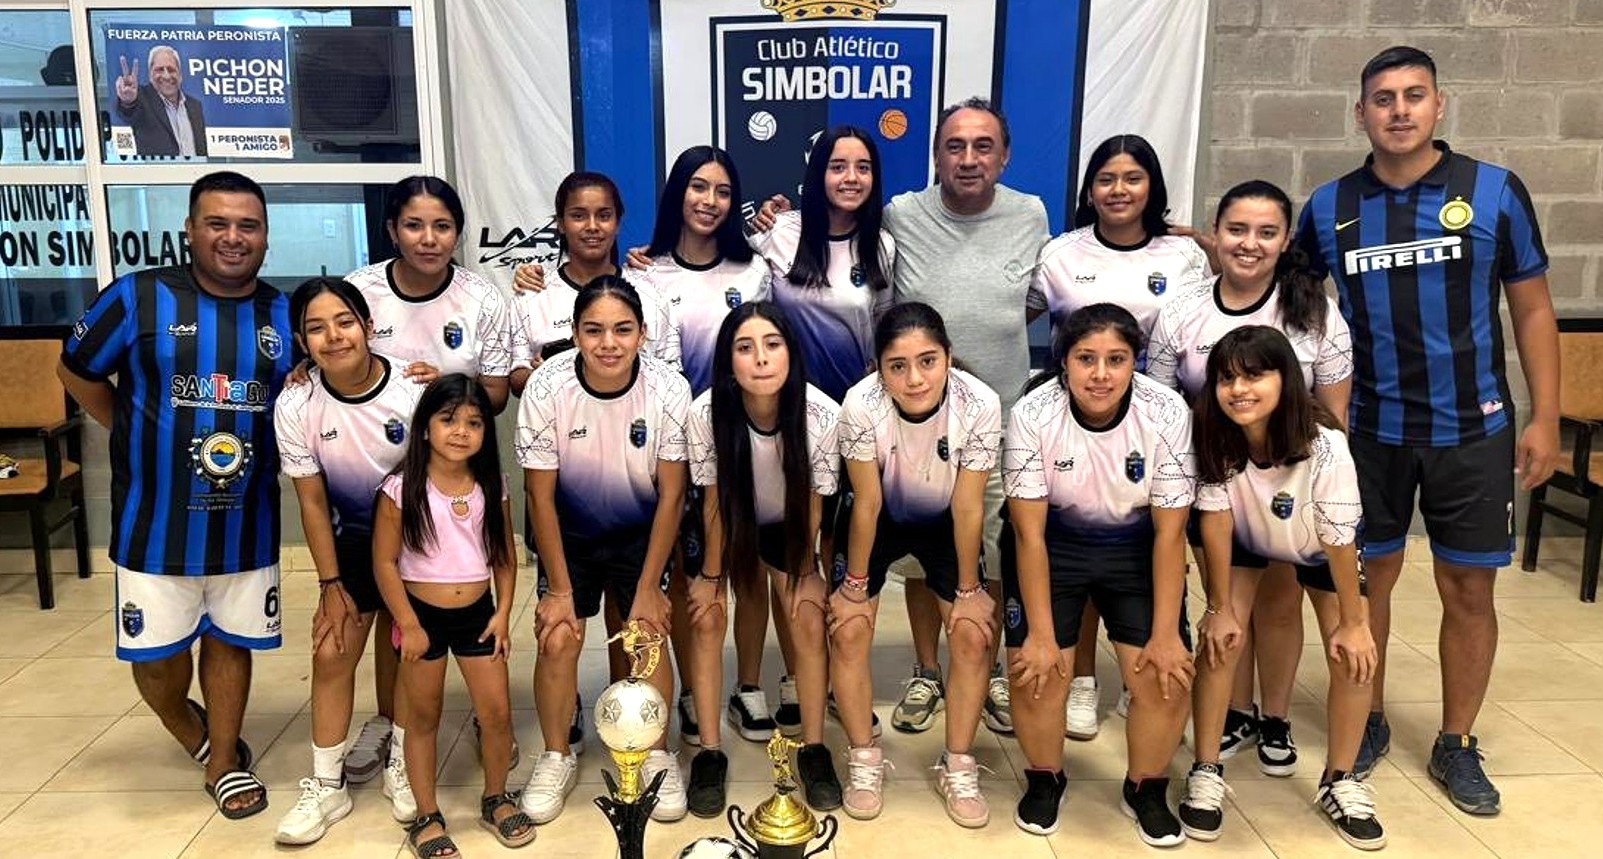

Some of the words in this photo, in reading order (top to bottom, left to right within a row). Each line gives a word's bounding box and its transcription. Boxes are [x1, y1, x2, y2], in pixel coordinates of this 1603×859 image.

[107, 29, 158, 40] FUERZA
[161, 30, 205, 41] PATRIA
[208, 30, 281, 41] PERONISTA
[757, 37, 807, 61] Club
[813, 35, 900, 60] Atlético
[188, 58, 283, 77] PICHON
[203, 77, 285, 96] NEDER
[742, 64, 913, 101] SIMBOLAR
[223, 96, 264, 104] SENADOR
[265, 96, 286, 104] 2025
[218, 134, 277, 144] PERONISTA
[242, 142, 278, 151] AMIGO
[1344, 235, 1463, 276] PIRELLI
[264, 586, 279, 618] 6
